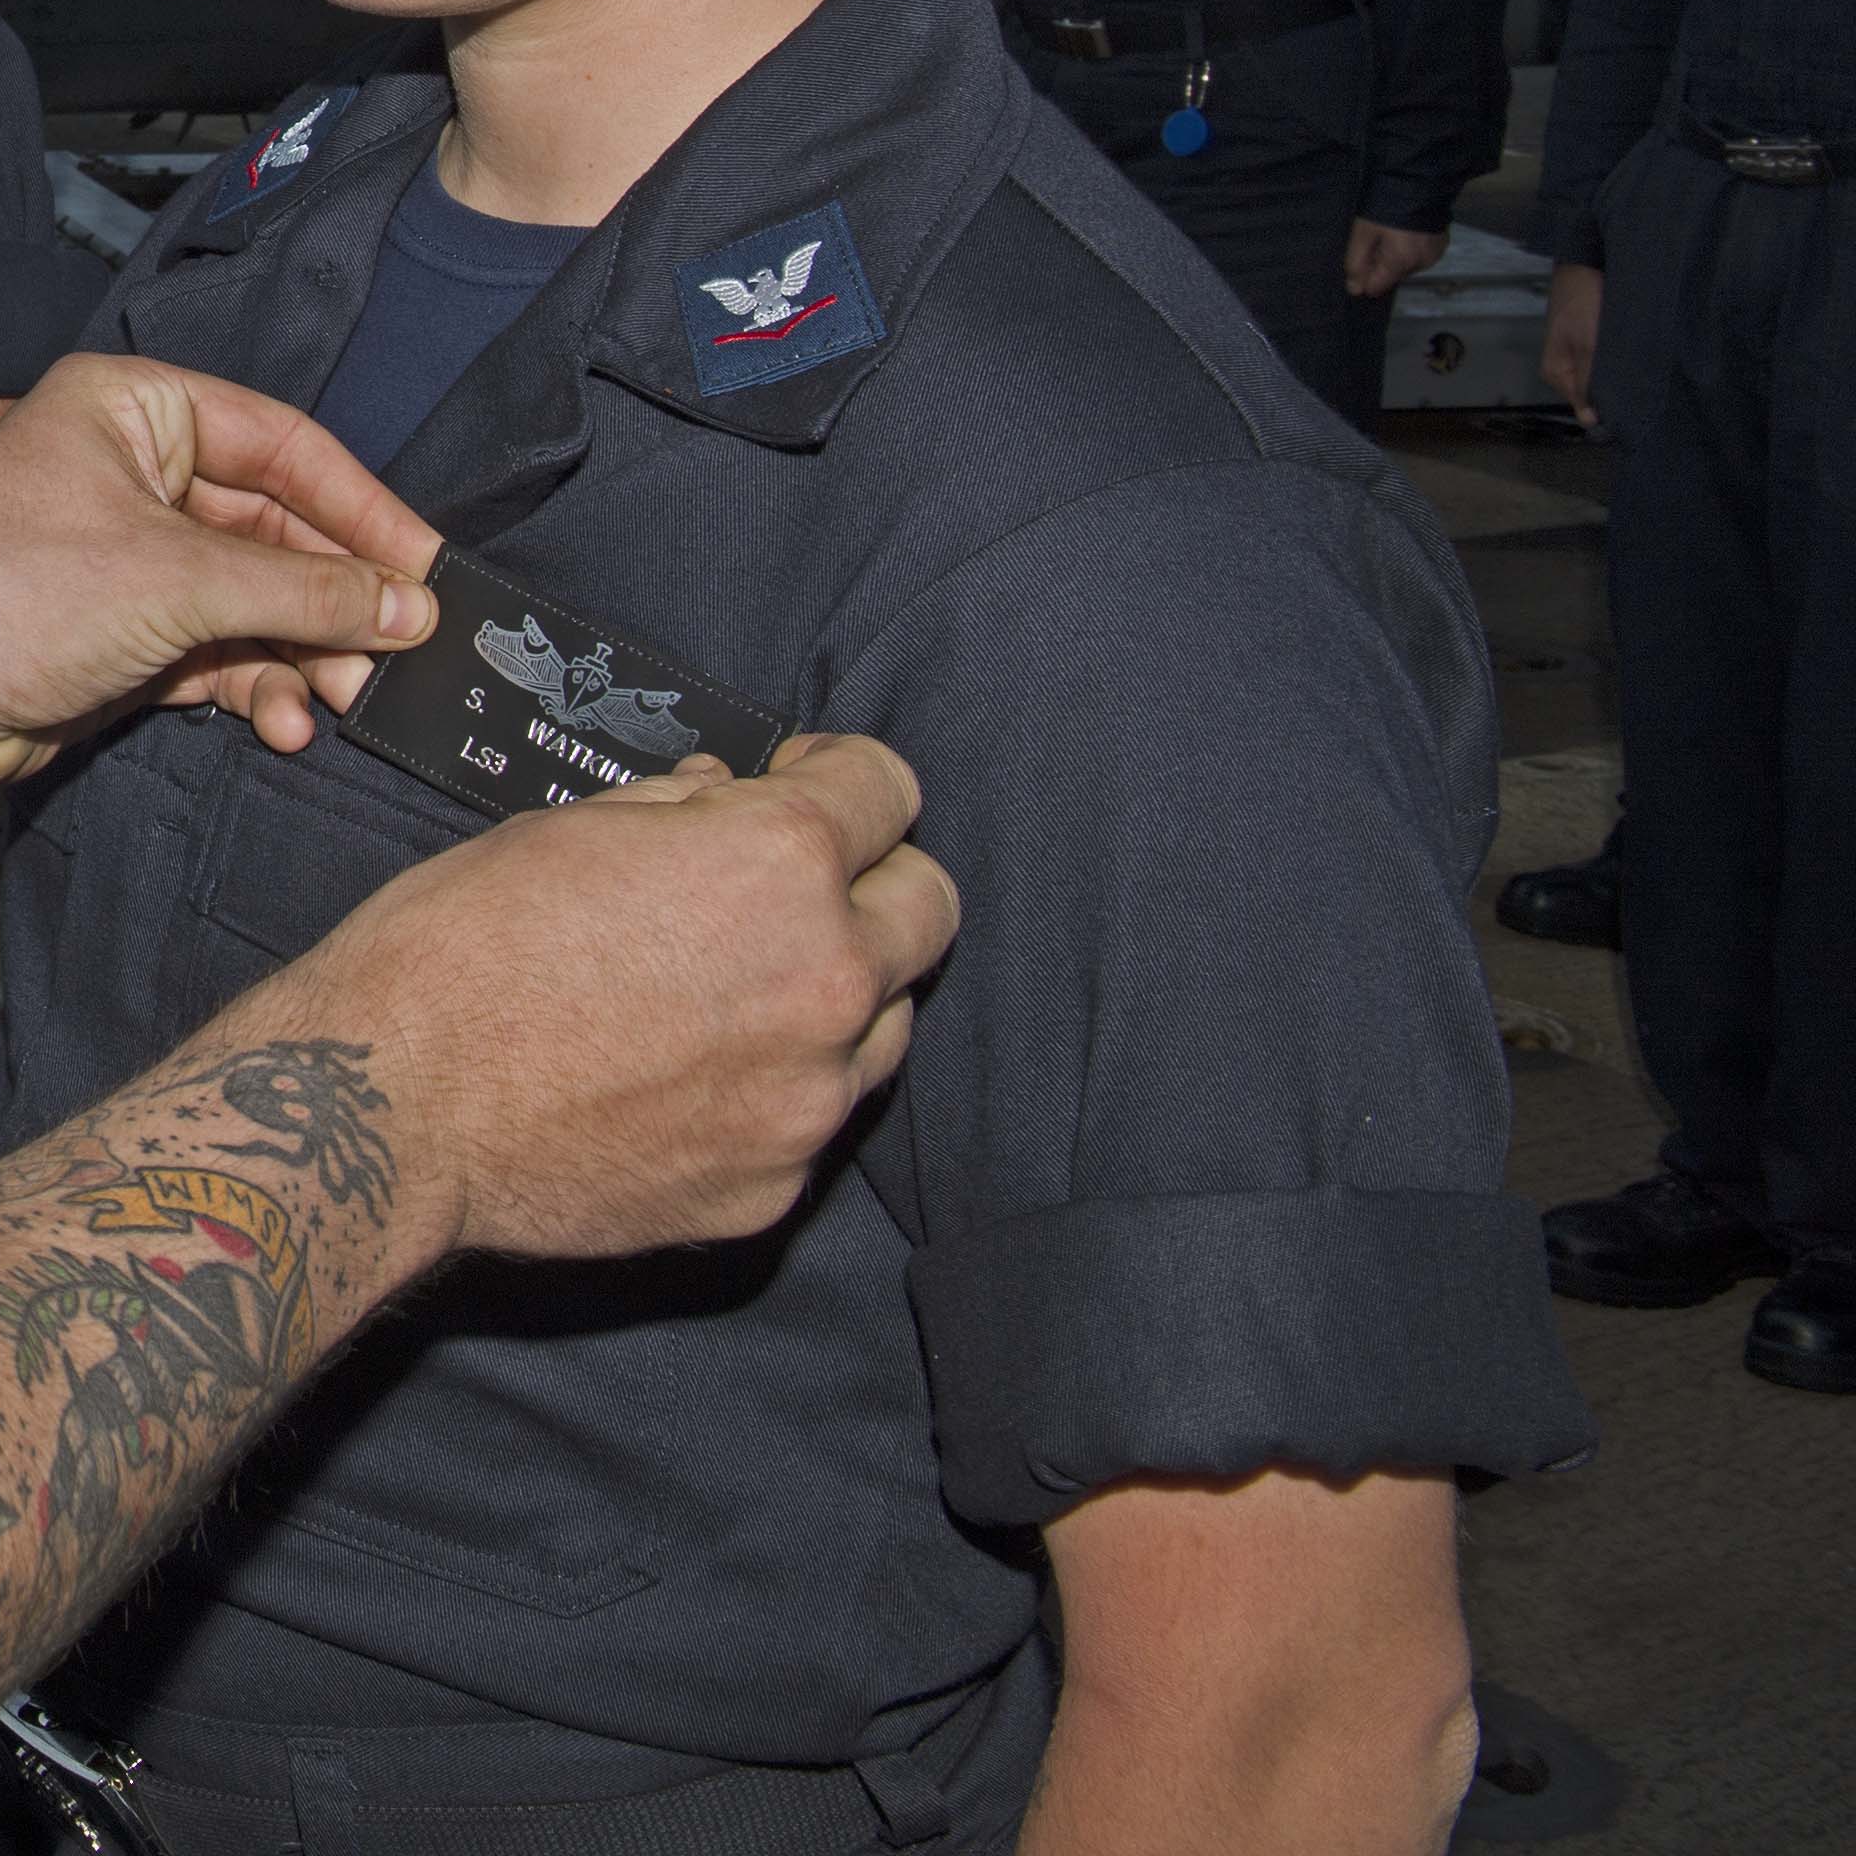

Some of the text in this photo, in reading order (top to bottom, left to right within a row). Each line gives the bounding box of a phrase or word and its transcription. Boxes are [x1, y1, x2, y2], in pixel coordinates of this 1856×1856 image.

[460, 735, 509, 775] LS3
[464, 687, 642, 787] S. WATKIN
